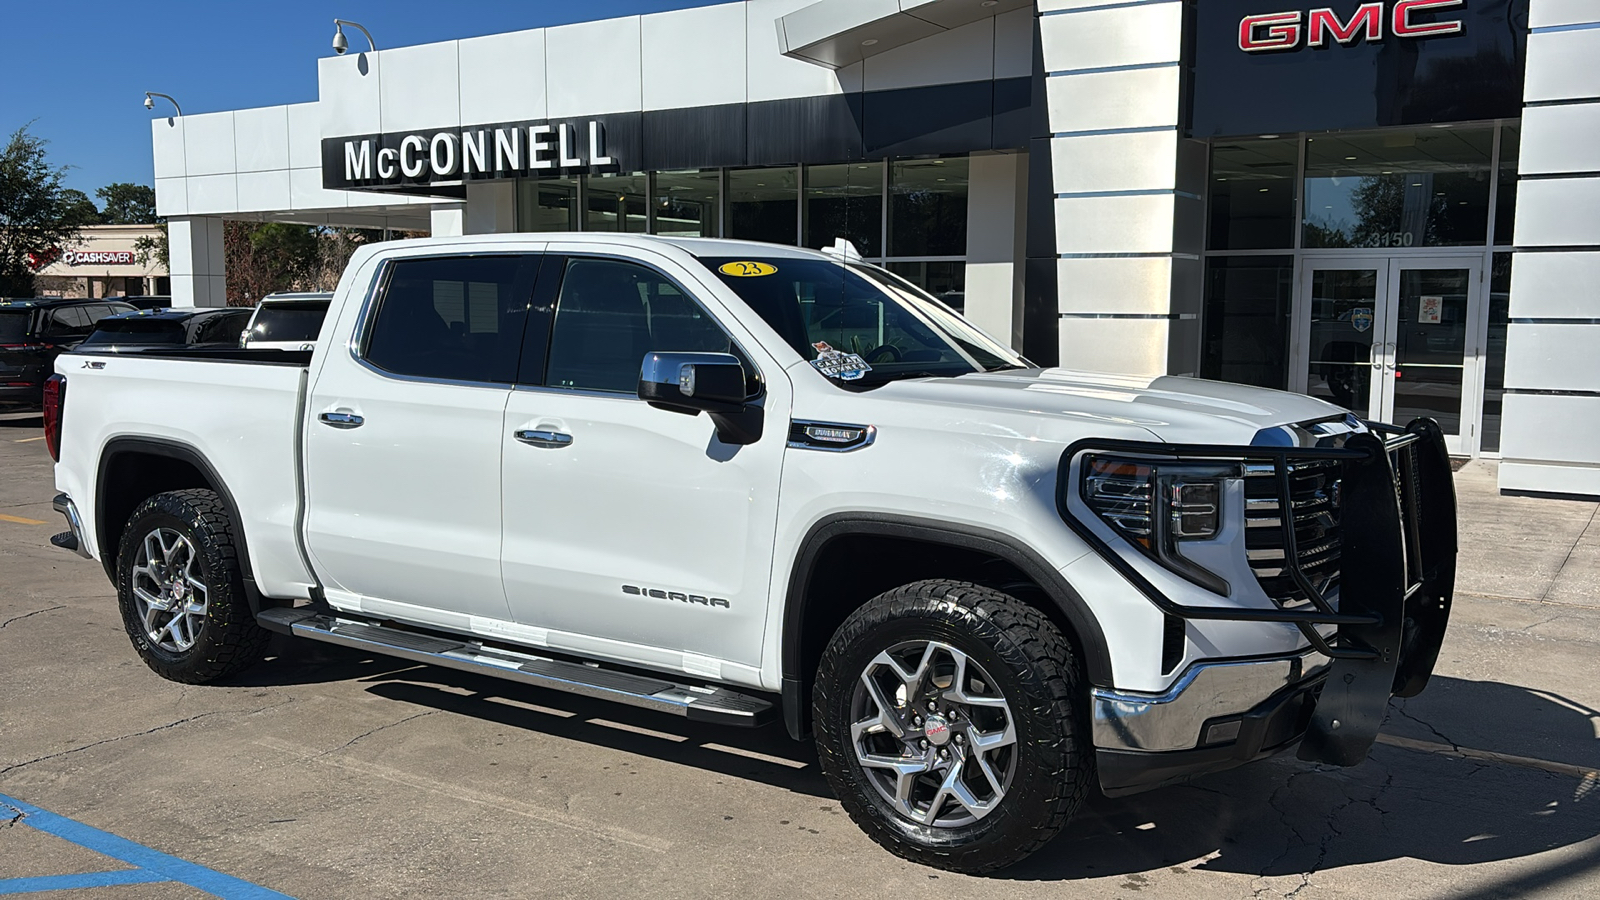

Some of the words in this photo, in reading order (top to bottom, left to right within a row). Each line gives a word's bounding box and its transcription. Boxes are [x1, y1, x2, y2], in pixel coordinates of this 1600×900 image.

[1238, 0, 1463, 51] GMC
[344, 121, 612, 181] McCONNELL
[1371, 231, 1413, 247] 3150
[735, 262, 762, 275] 23
[621, 584, 730, 608] SIERRA
[926, 725, 947, 736] GMC
